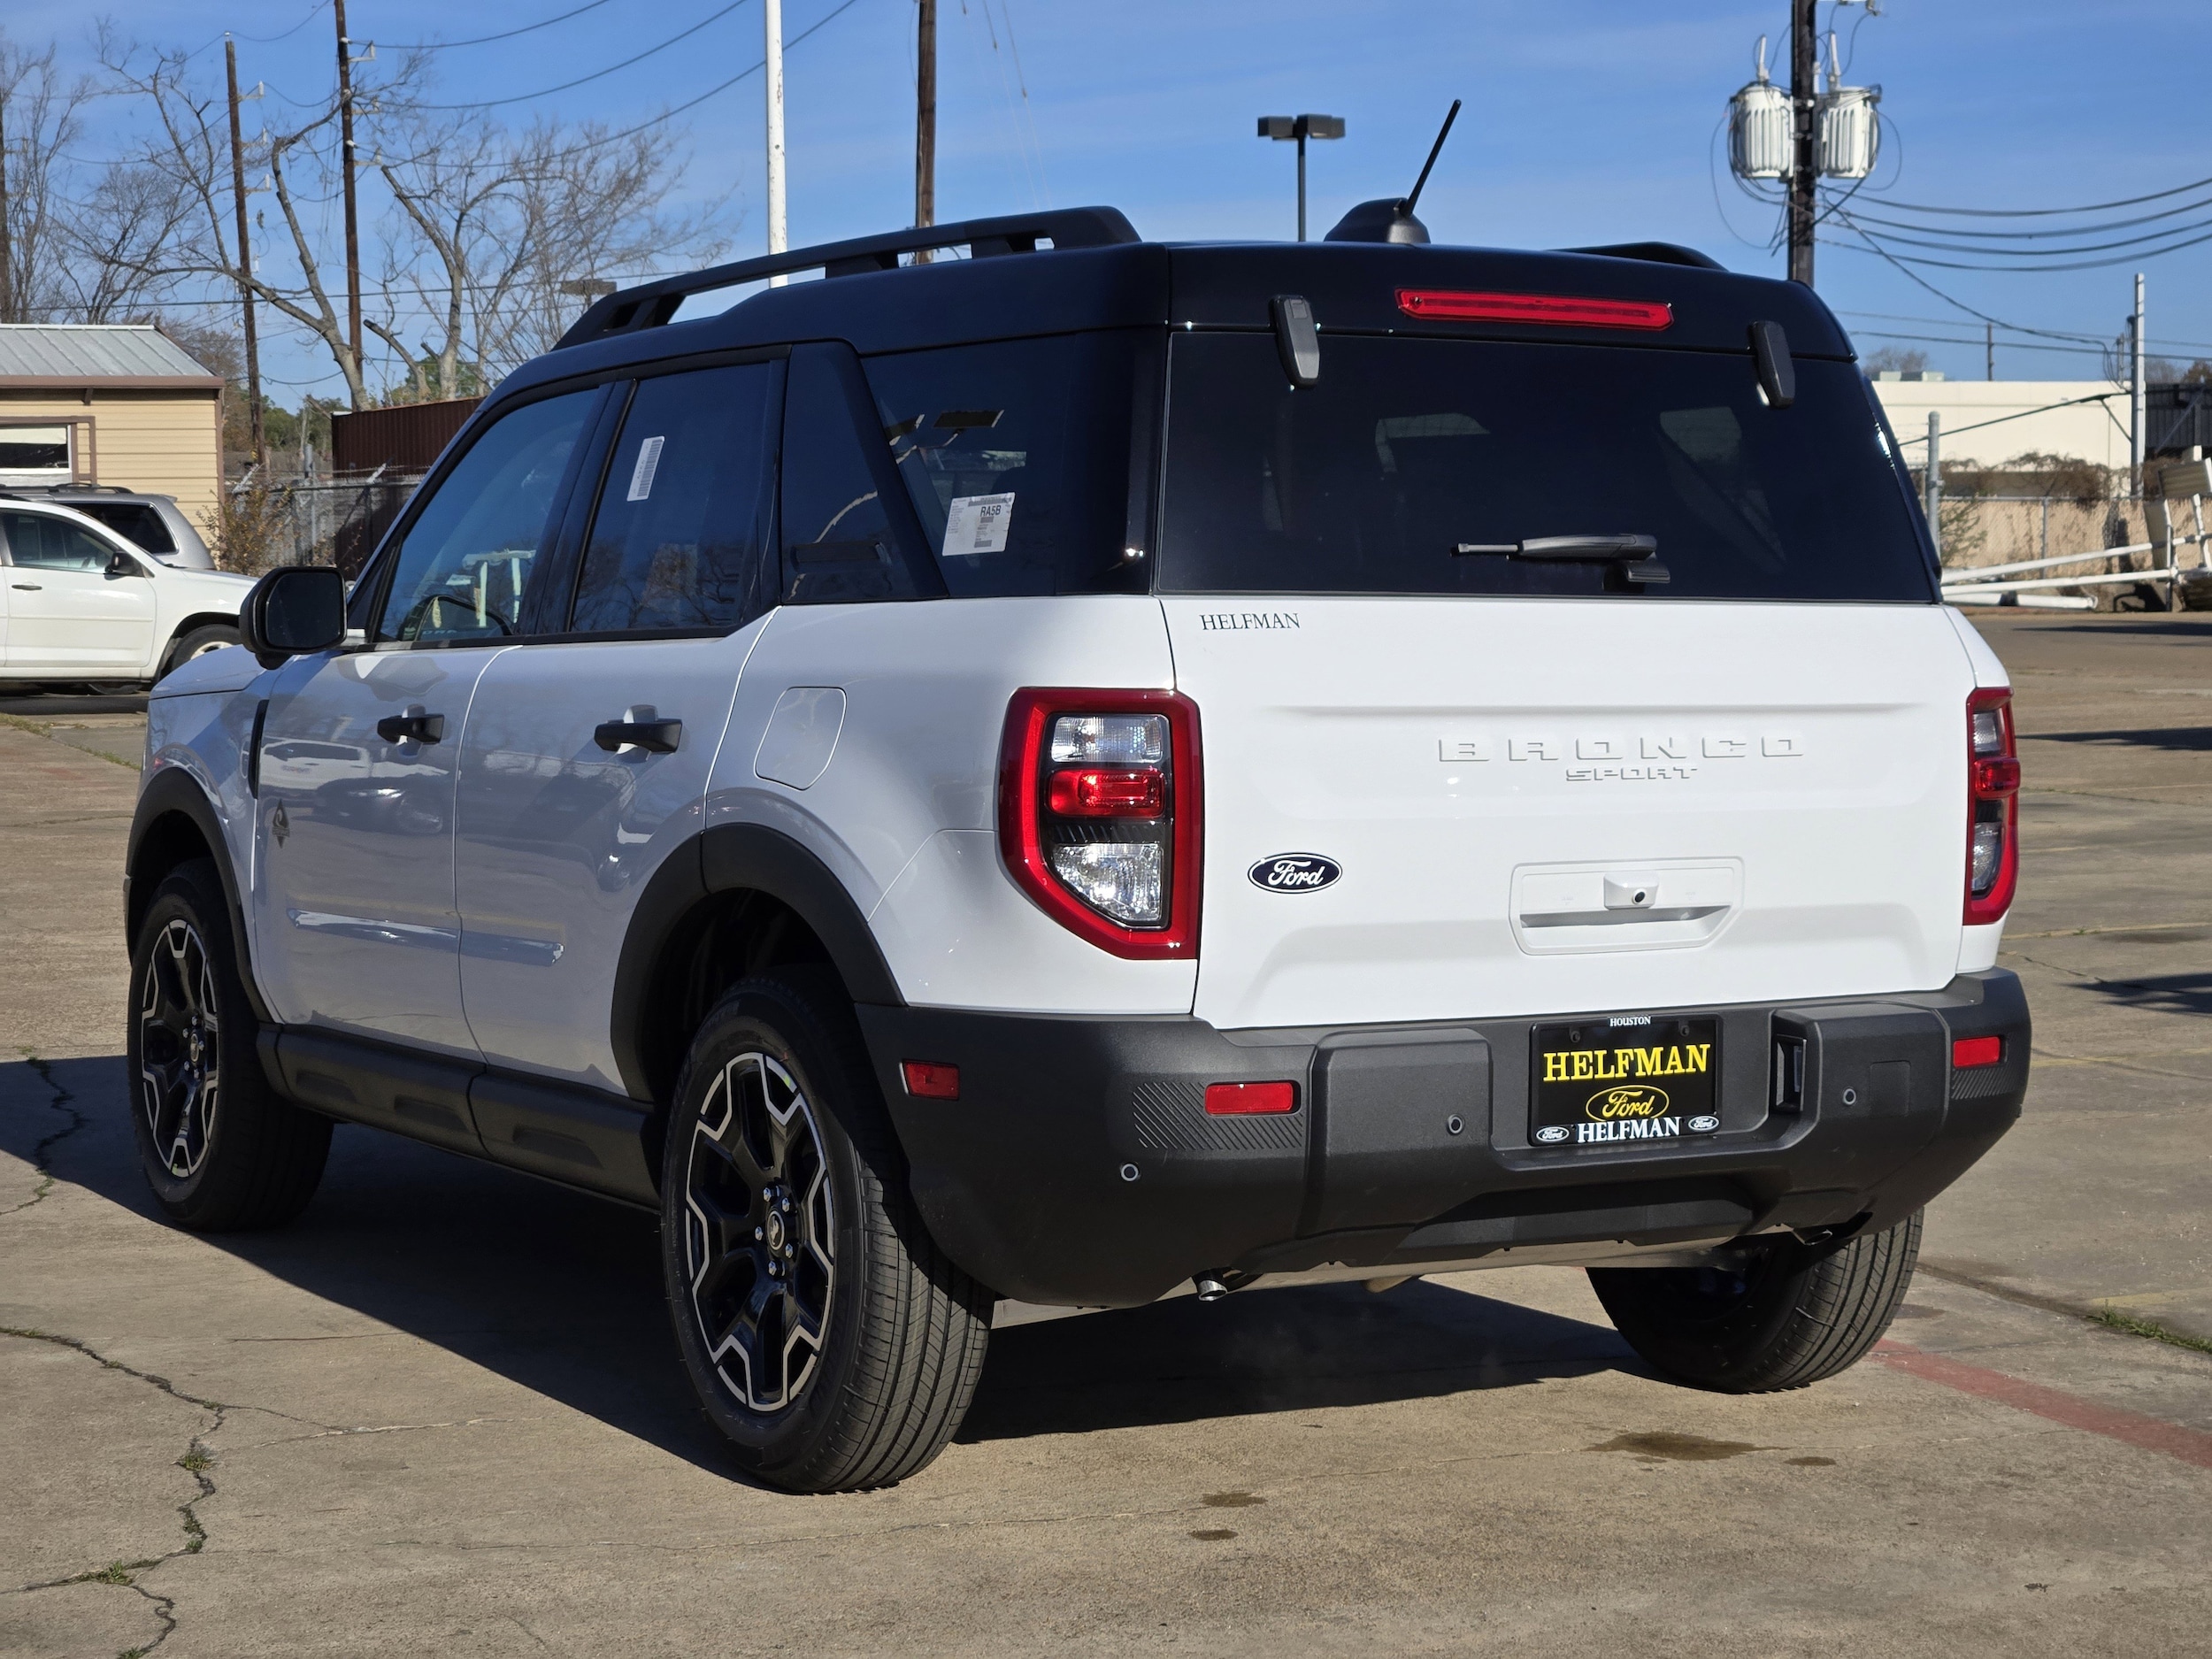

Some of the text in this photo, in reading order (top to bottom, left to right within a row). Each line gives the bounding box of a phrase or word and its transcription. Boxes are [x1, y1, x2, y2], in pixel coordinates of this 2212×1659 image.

[979, 504, 1002, 517] RA5B
[1200, 612, 1301, 631] HELFMAN
[1438, 733, 1804, 762] BRONCO
[1565, 765, 1698, 782] SPORT
[1267, 859, 1326, 887] Ford
[1609, 1016, 1652, 1027] HOUSTON
[1543, 1043, 1711, 1082] HELFMAN
[1601, 1090, 1655, 1118] Ford
[1541, 1117, 1714, 1144] Ford HELFMAN Ford
